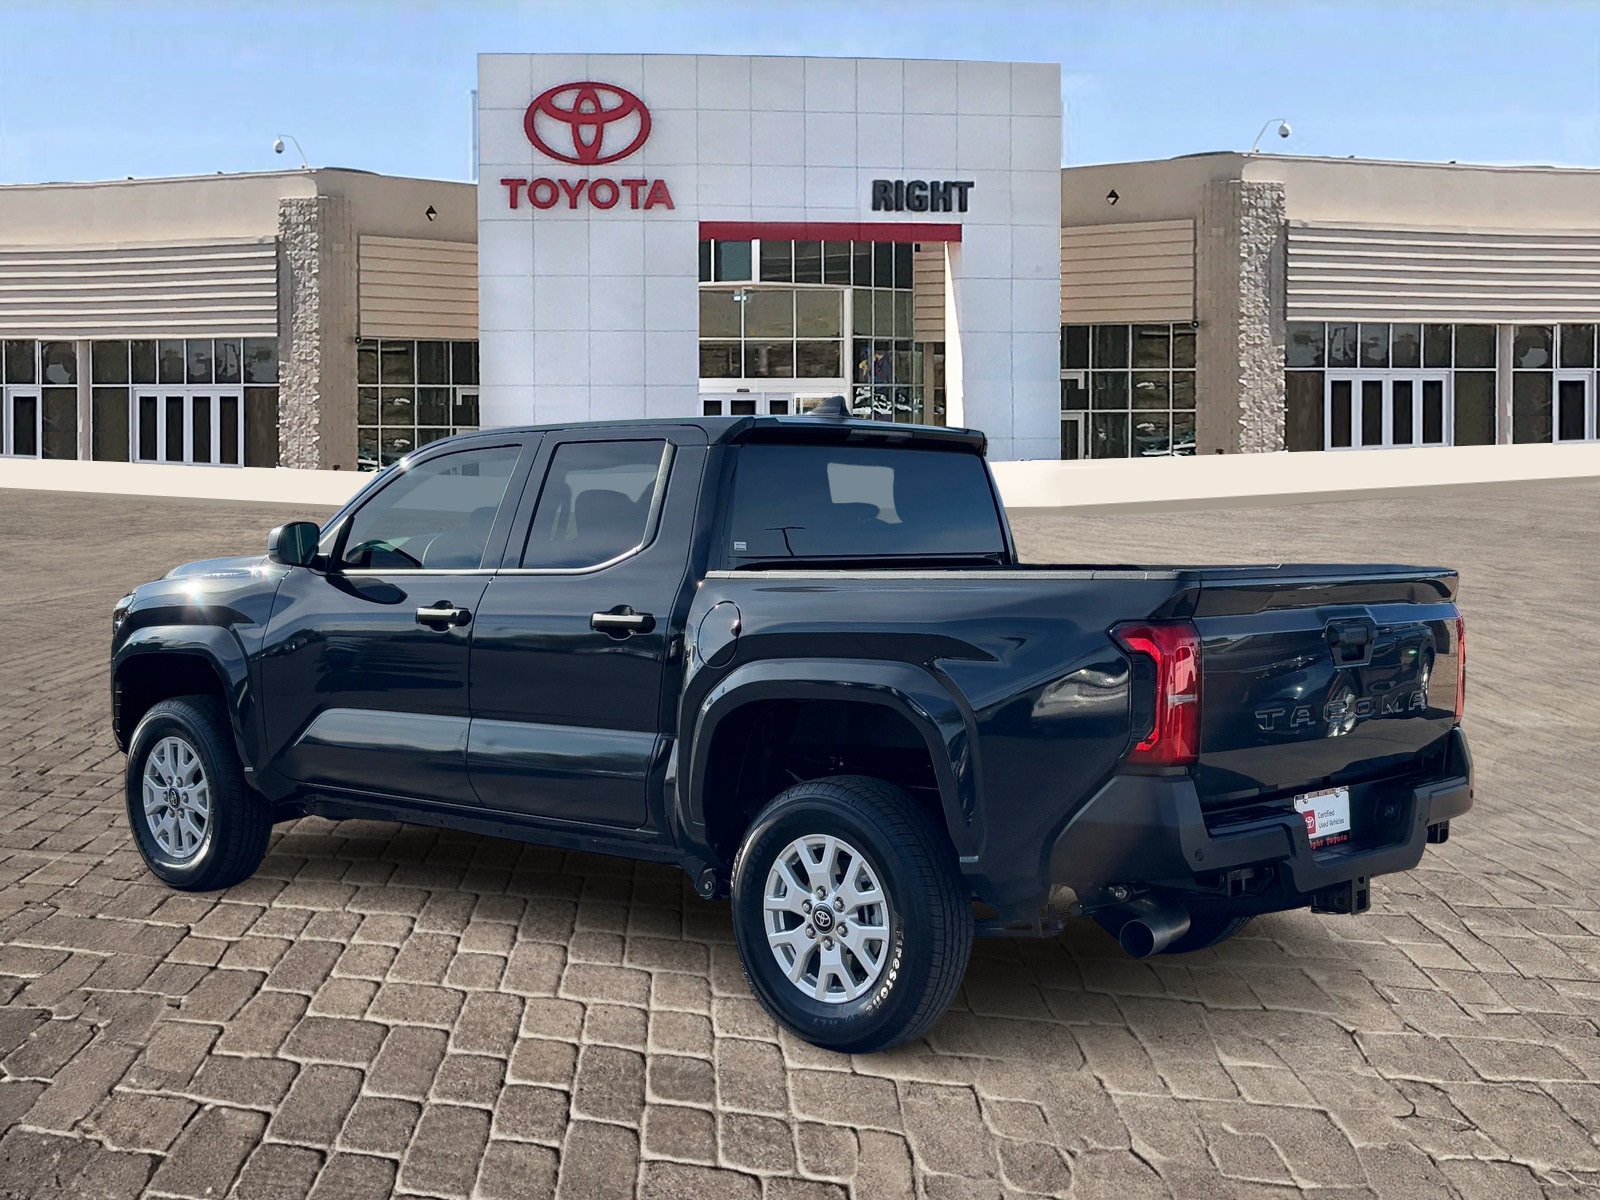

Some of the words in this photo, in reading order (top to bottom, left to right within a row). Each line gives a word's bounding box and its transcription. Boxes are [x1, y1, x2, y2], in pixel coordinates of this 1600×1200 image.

[500, 178, 675, 209] TOYOTA
[872, 180, 975, 212] RIGHT
[1254, 690, 1428, 731] TACOMA
[1317, 809, 1335, 818] Certified
[1318, 821, 1329, 829] Used
[1329, 818, 1345, 827] Vehicles
